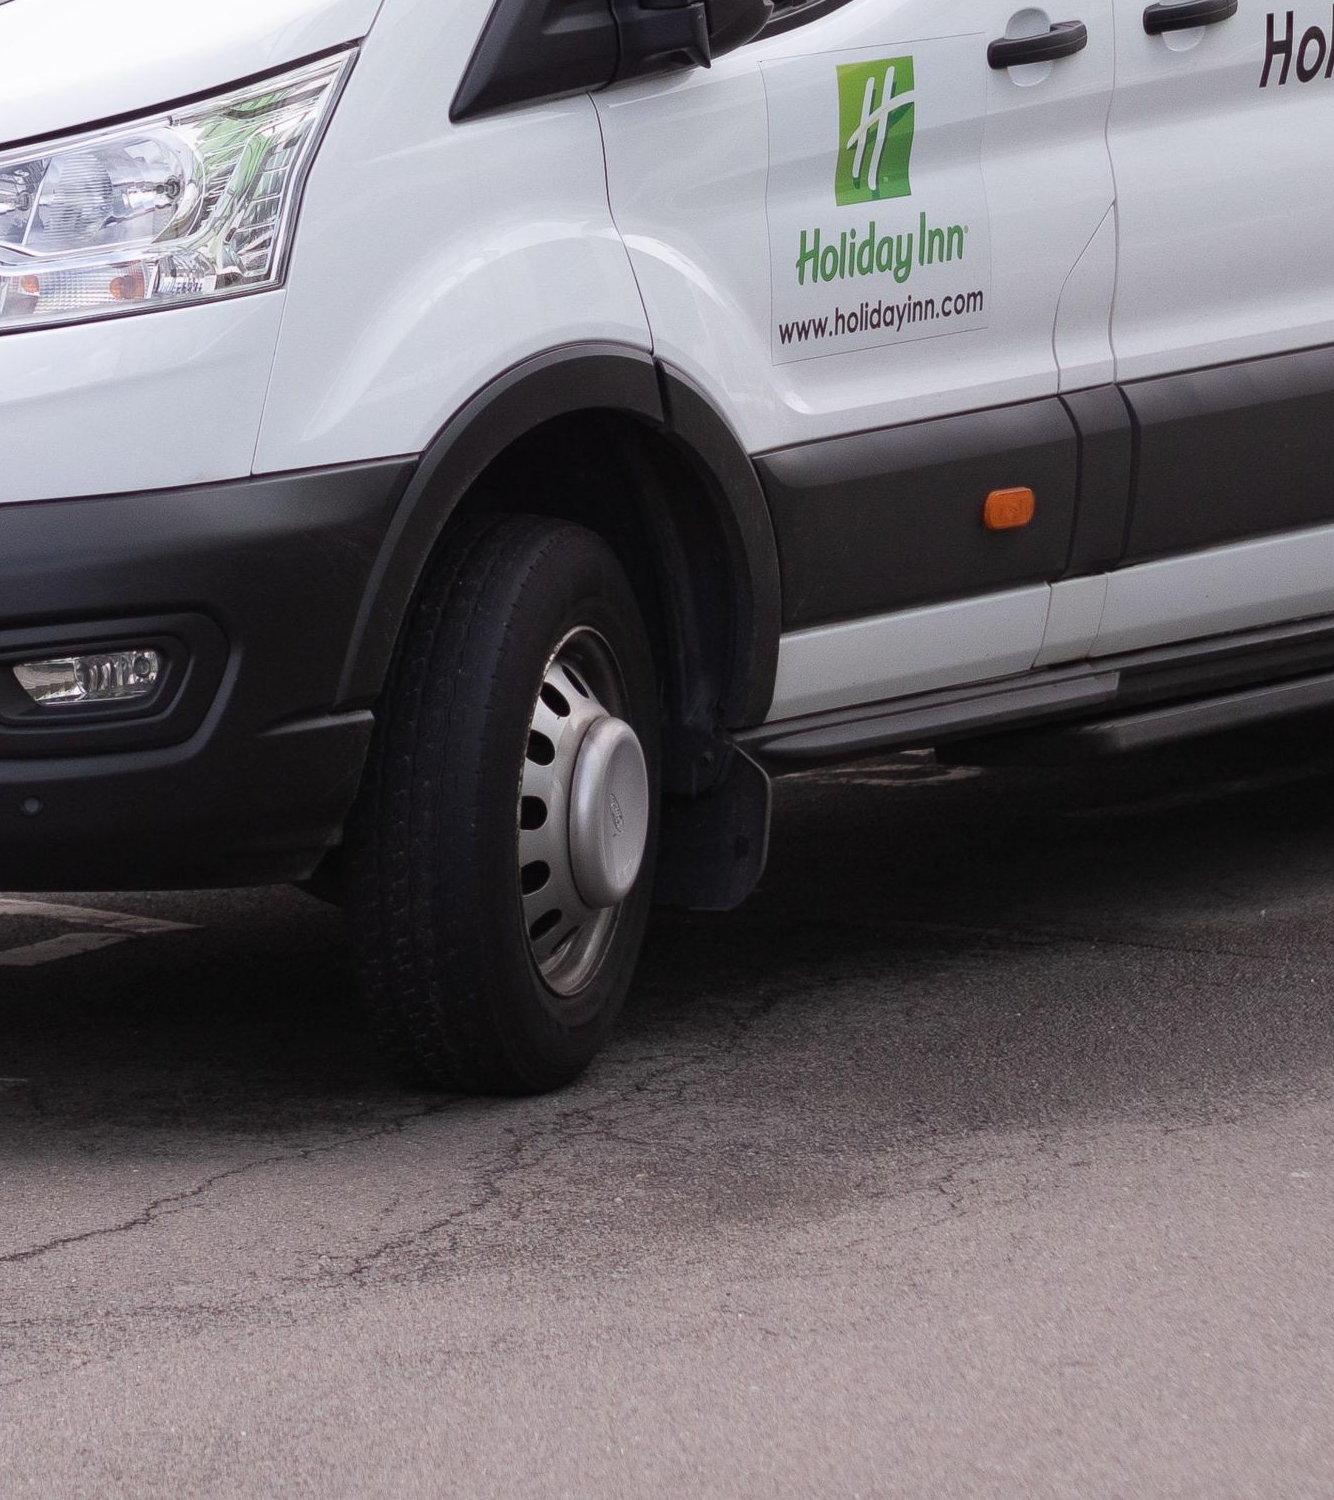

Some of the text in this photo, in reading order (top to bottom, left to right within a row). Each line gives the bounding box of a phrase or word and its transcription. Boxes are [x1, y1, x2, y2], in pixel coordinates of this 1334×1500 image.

[795, 212, 964, 286] Holiday Inn
[778, 288, 984, 345] www.holidayinn.com
